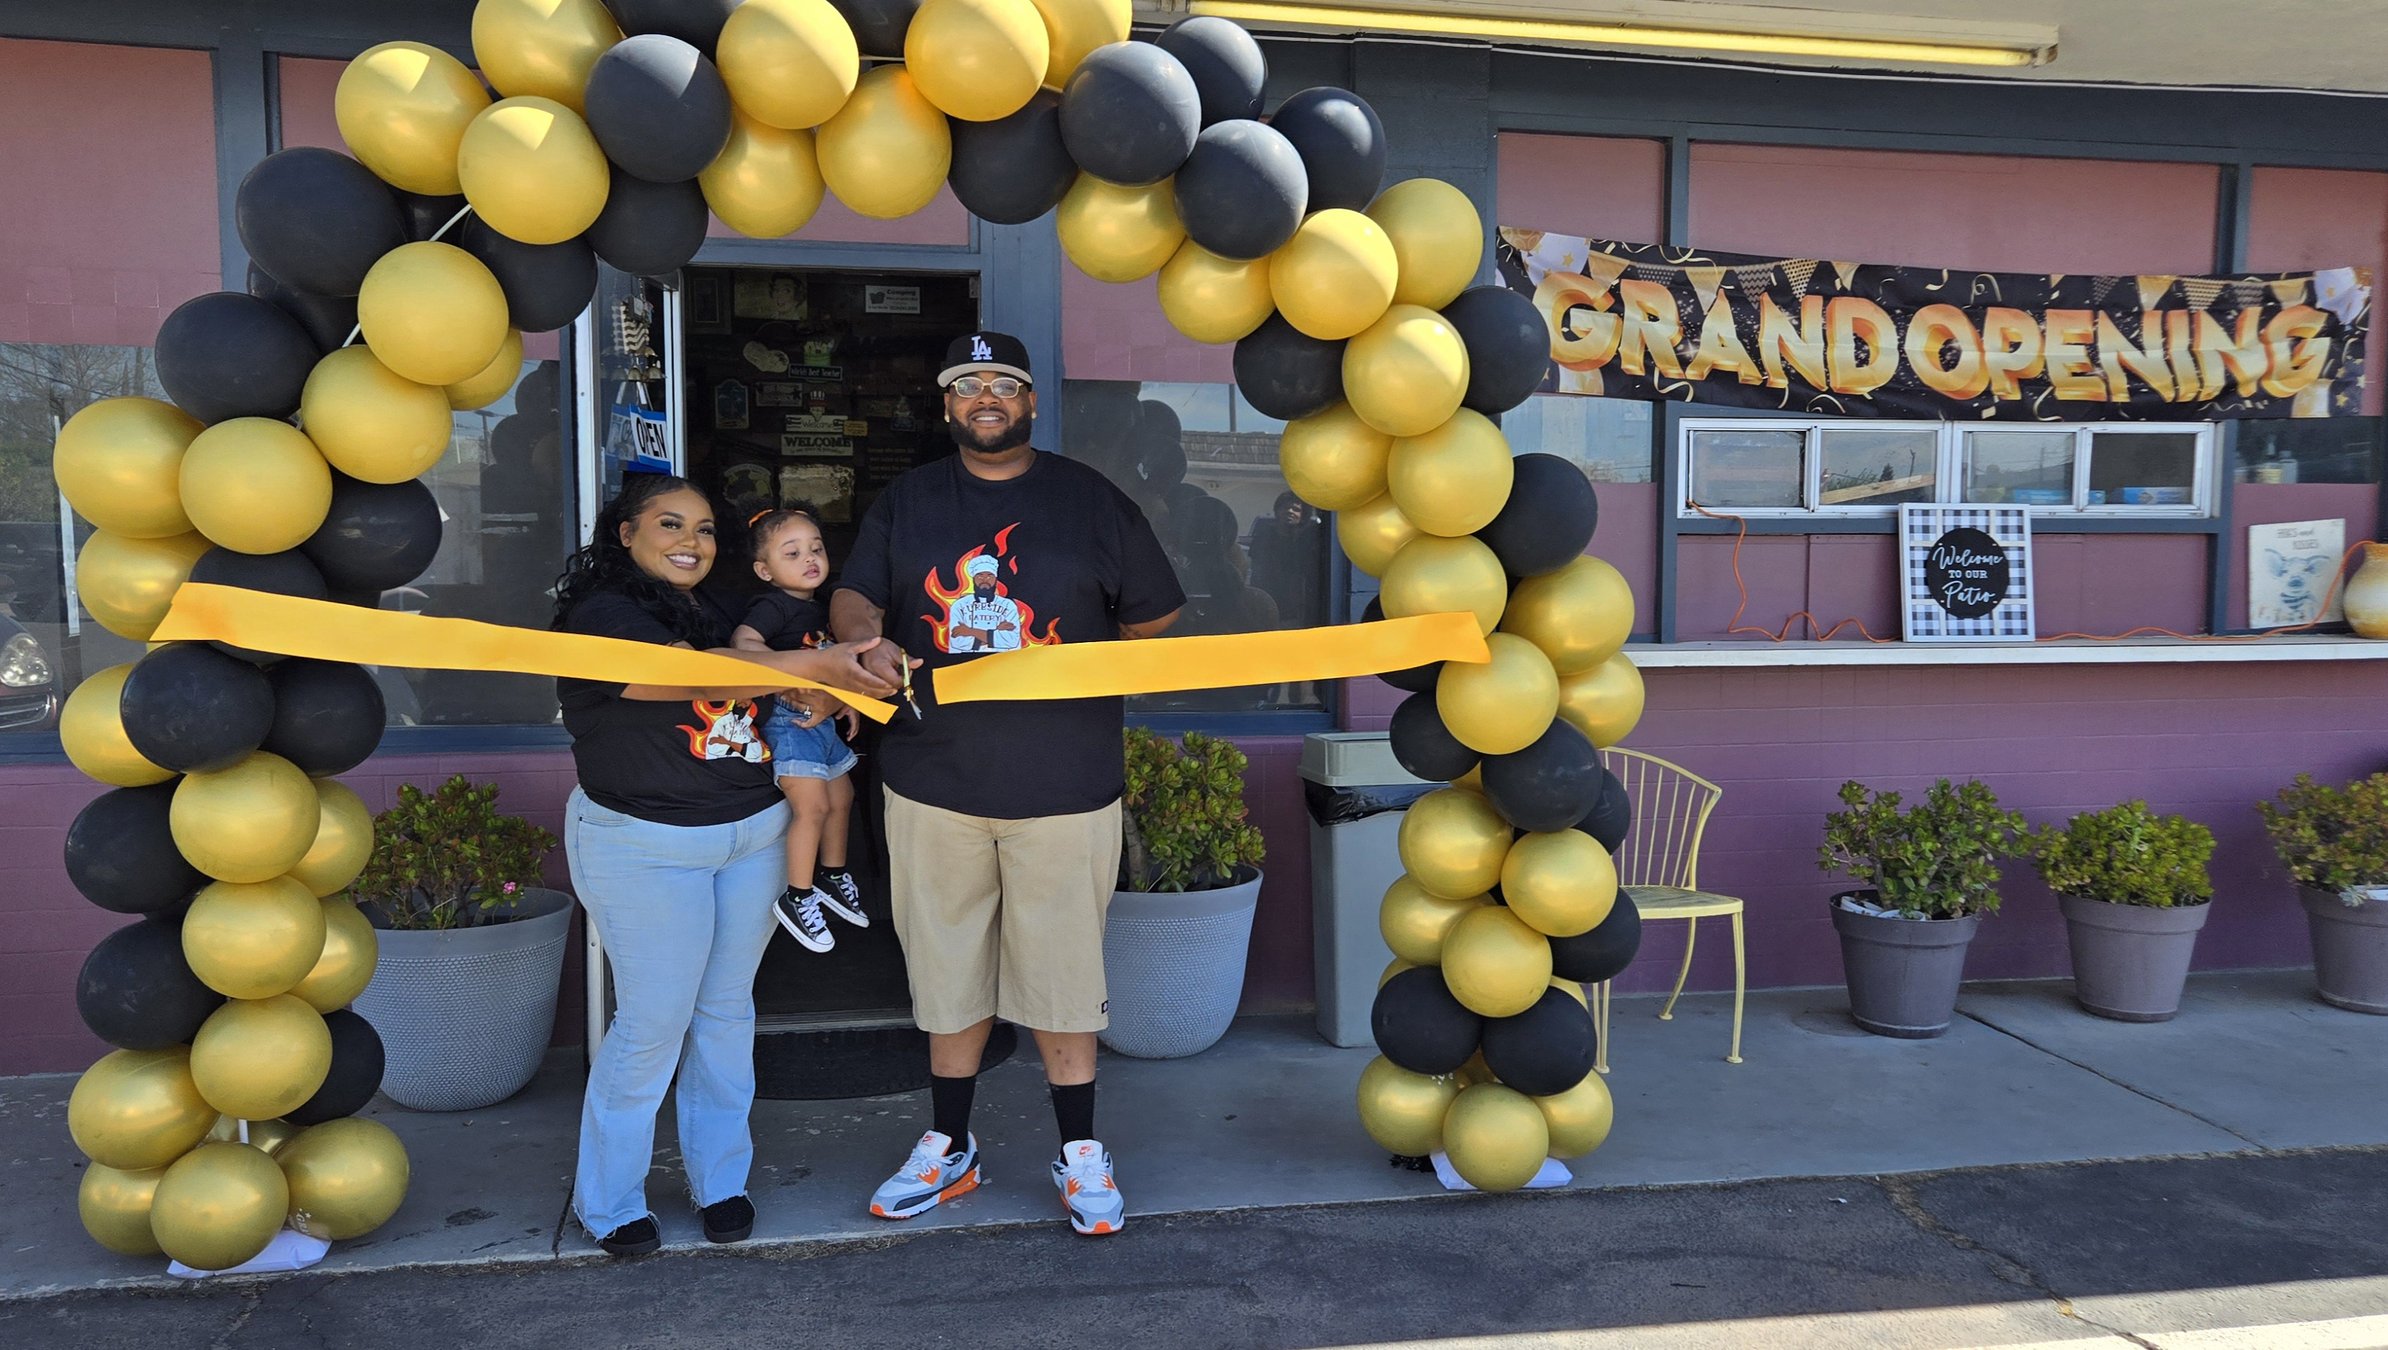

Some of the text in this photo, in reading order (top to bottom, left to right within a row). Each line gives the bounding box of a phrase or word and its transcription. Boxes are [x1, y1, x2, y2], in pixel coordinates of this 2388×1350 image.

[971, 335, 993, 360] LA
[1532, 271, 2331, 402] GRAND OPENING
[636, 416, 668, 459] OPEN
[784, 436, 851, 447] WELCOME
[1932, 545, 2004, 569] Welcome
[1948, 570, 1988, 579] TO OUR
[1942, 580, 1996, 609] Patio
